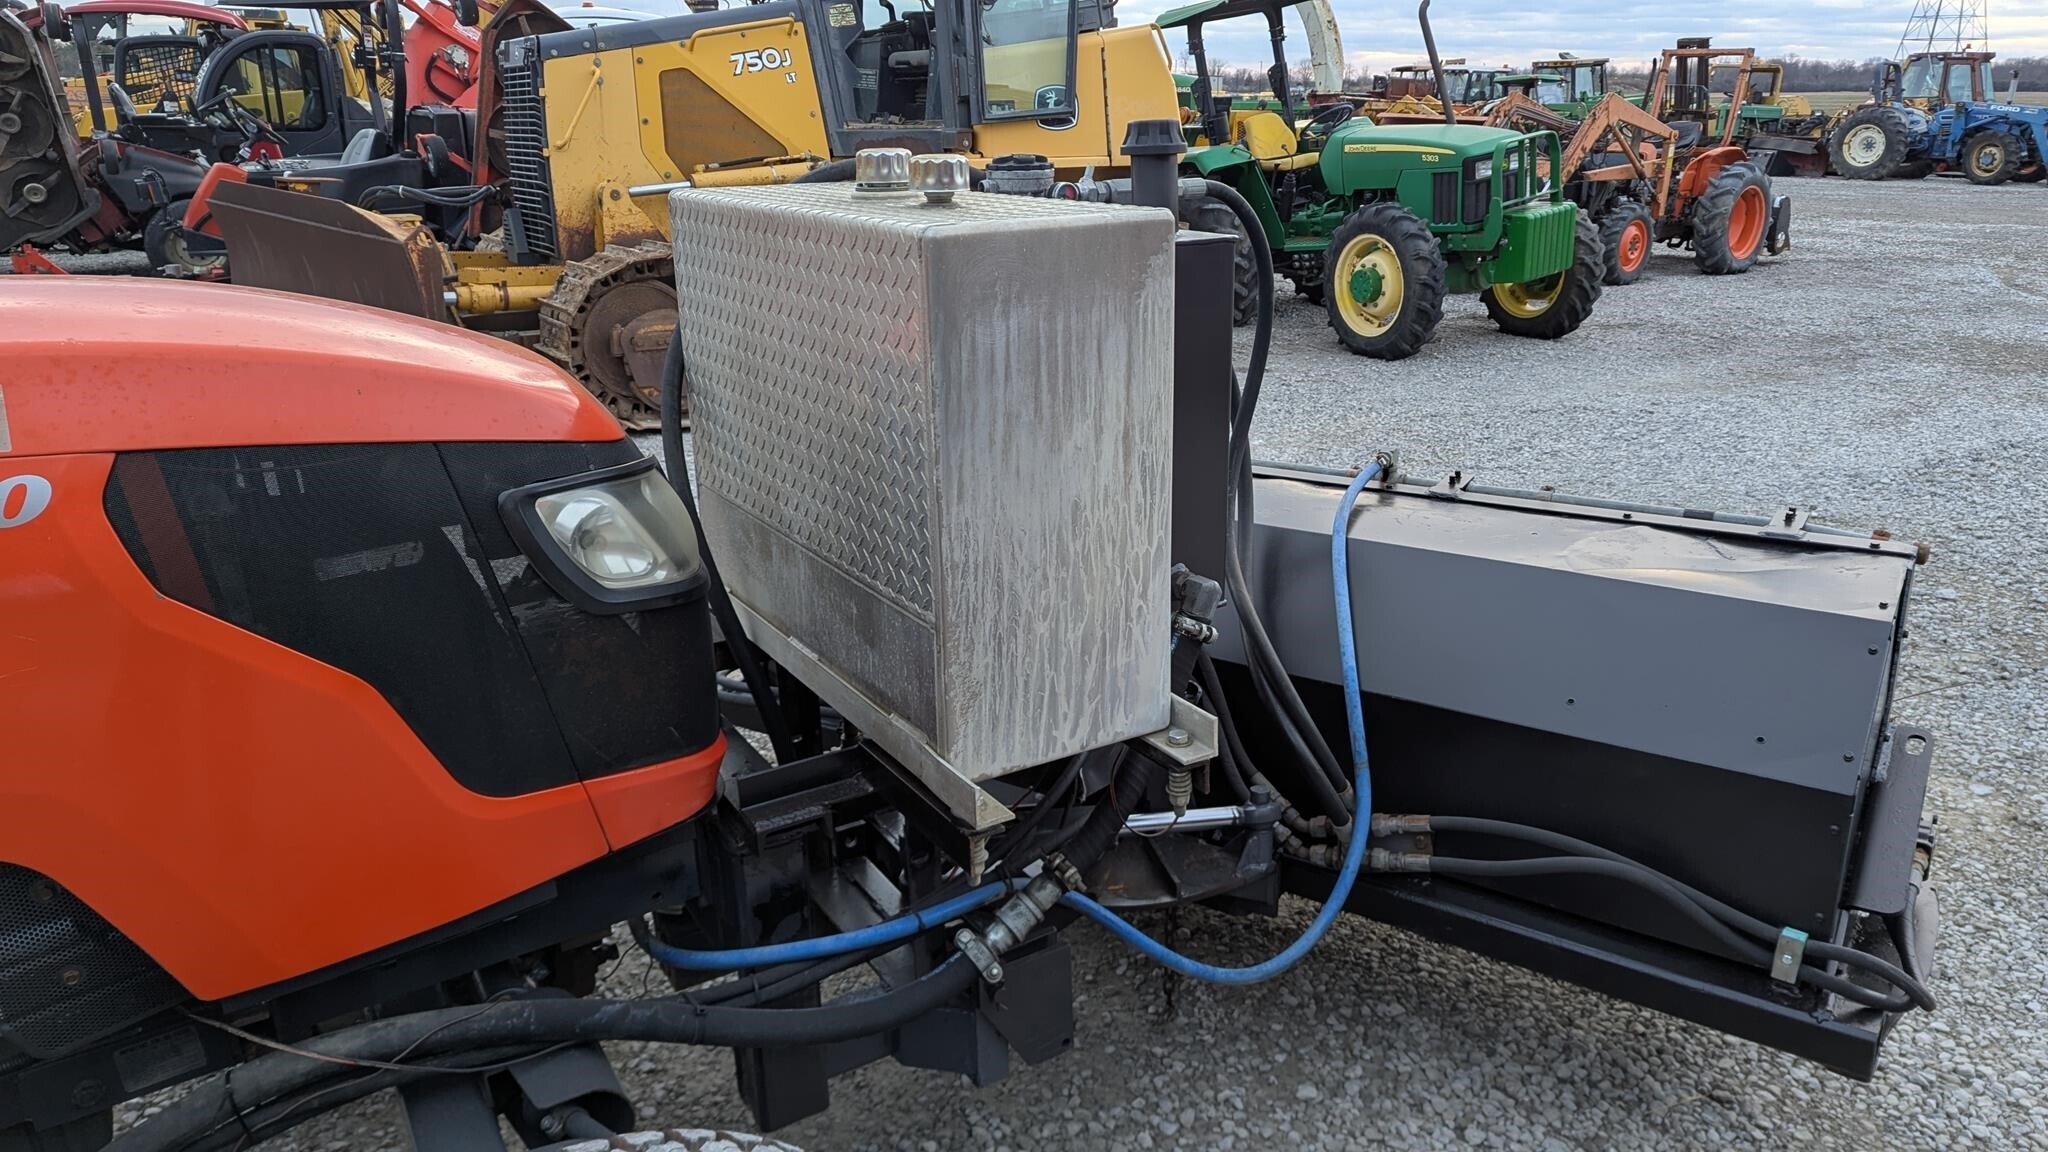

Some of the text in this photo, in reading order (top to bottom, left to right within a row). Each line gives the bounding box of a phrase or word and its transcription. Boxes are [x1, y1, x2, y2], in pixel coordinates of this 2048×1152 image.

[729, 47, 792, 76] 750J
[785, 72, 797, 84] LT
[1990, 104, 2021, 113] FORD
[1422, 154, 1439, 162] 5303
